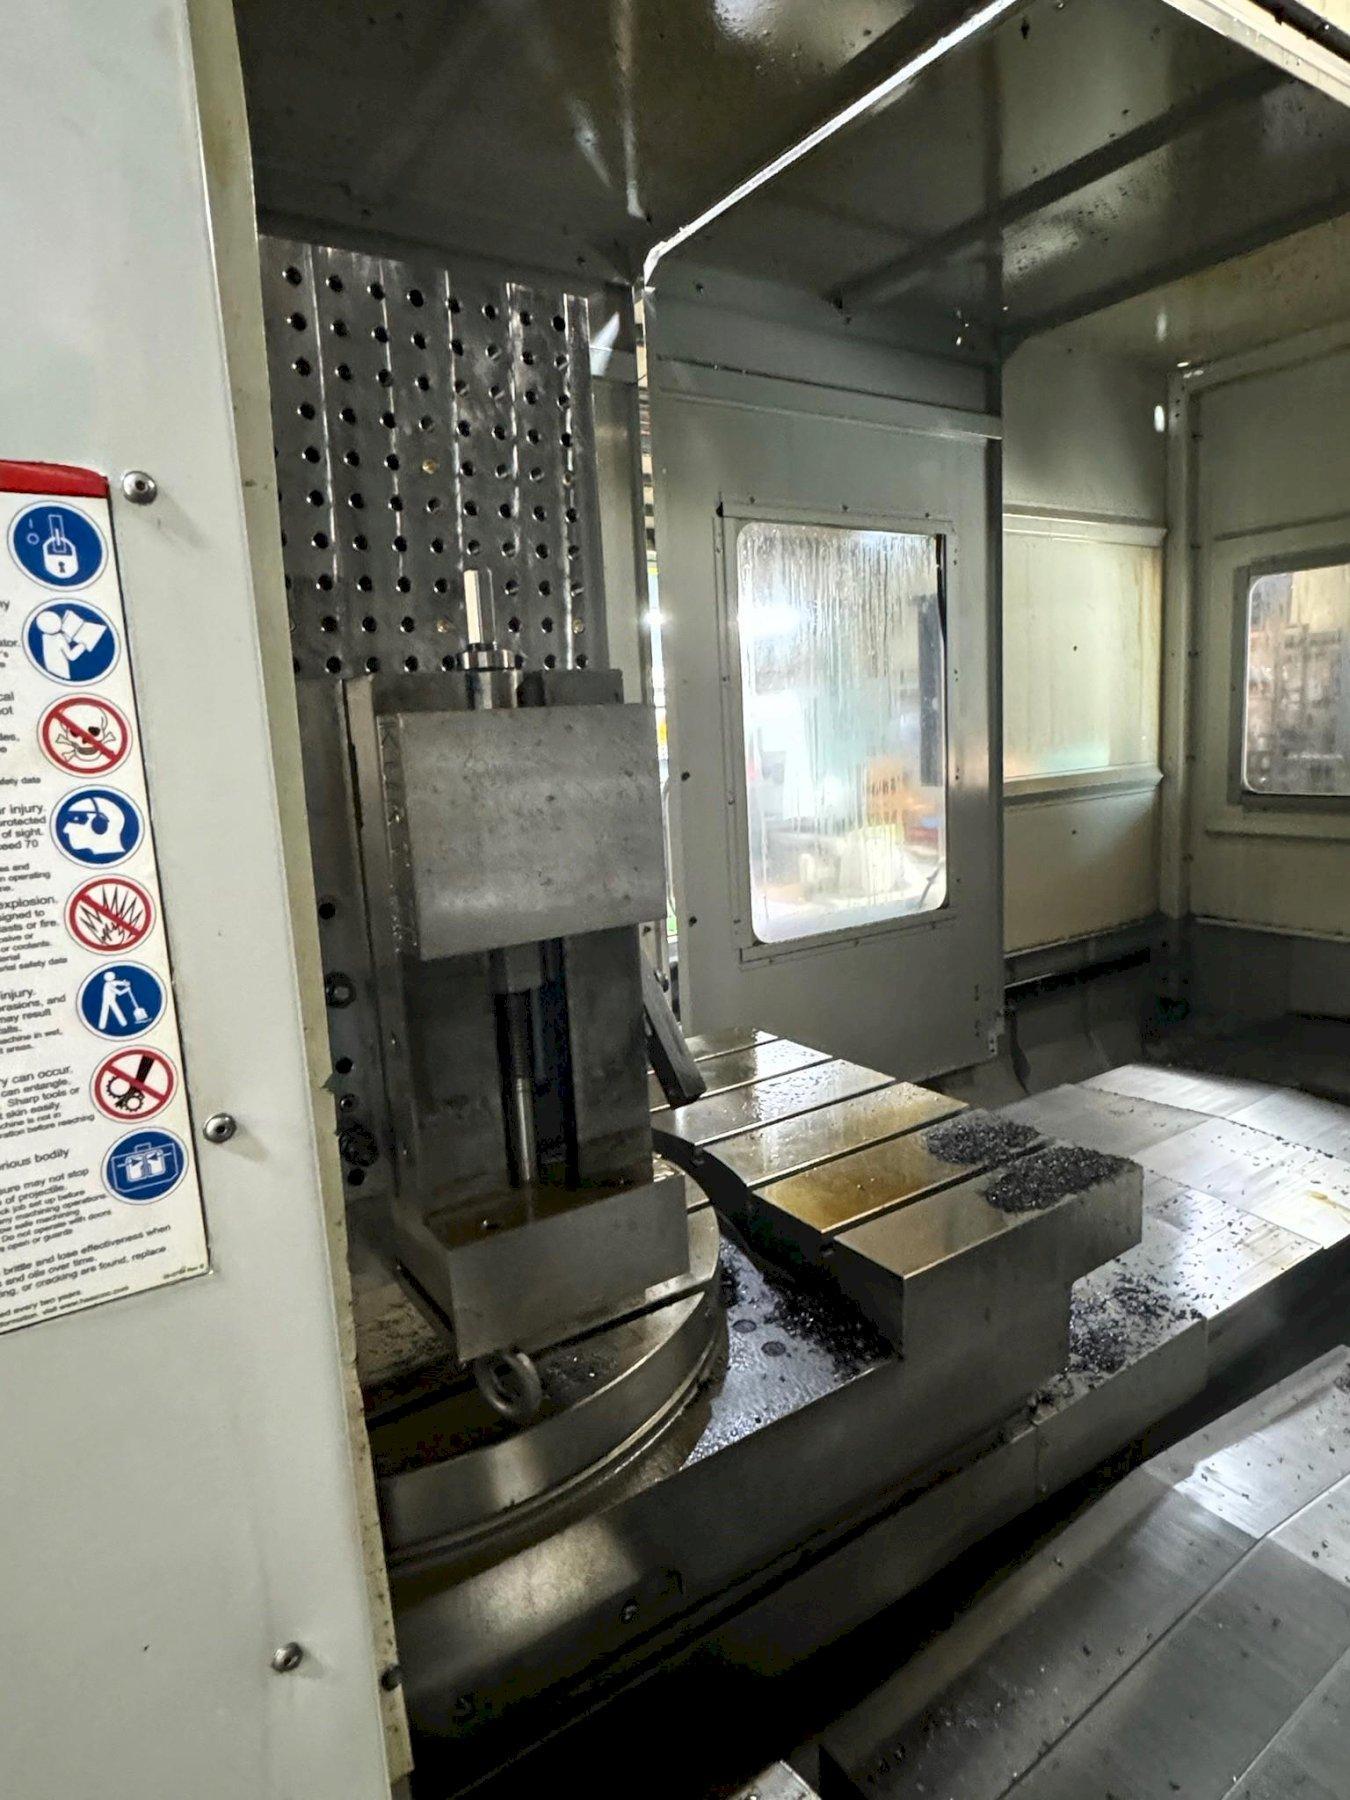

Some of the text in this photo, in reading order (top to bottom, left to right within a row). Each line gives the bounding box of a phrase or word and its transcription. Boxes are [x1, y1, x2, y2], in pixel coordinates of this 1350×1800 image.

[25, 839, 39, 848] 70
[46, 994, 66, 1005] and
[12, 1073, 35, 1084] can
[37, 1066, 73, 1079] occur.
[1, 1088, 21, 1097] can
[7, 1087, 80, 1108] Sharp tools or
[34, 1148, 69, 1163] bodily
[48, 1173, 65, 1183] not
[67, 1168, 89, 1179] stop
[35, 1255, 55, 1267] and
[5, 1273, 25, 1285] and
[48, 1263, 70, 1274] over
[21, 1283, 33, 1292] or
[35, 1271, 78, 1287] cracking
[80, 1265, 97, 1275] are
[131, 1246, 167, 1260] replace
